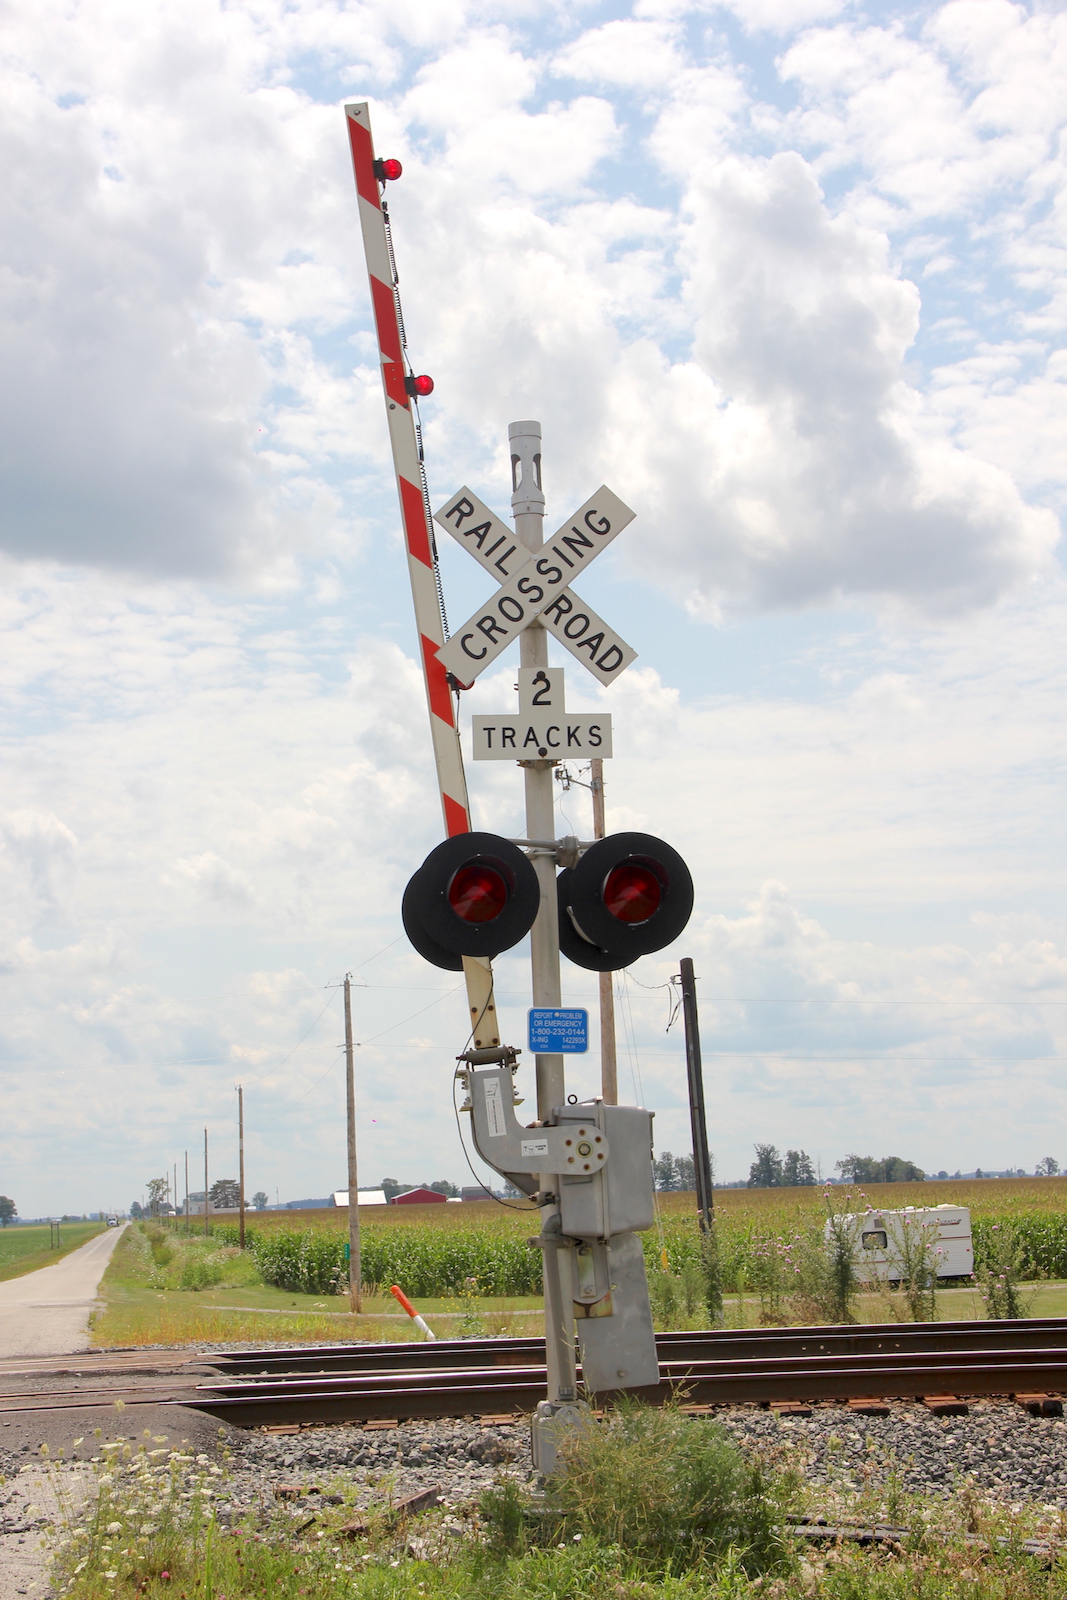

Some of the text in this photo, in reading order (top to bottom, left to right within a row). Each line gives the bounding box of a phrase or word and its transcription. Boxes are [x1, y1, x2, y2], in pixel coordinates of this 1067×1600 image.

[445, 496, 517, 576] RAIL
[460, 510, 611, 660] CROSSING
[543, 593, 624, 672] ROAD
[531, 675, 552, 706] 2
[483, 725, 603, 748] TRACKS
